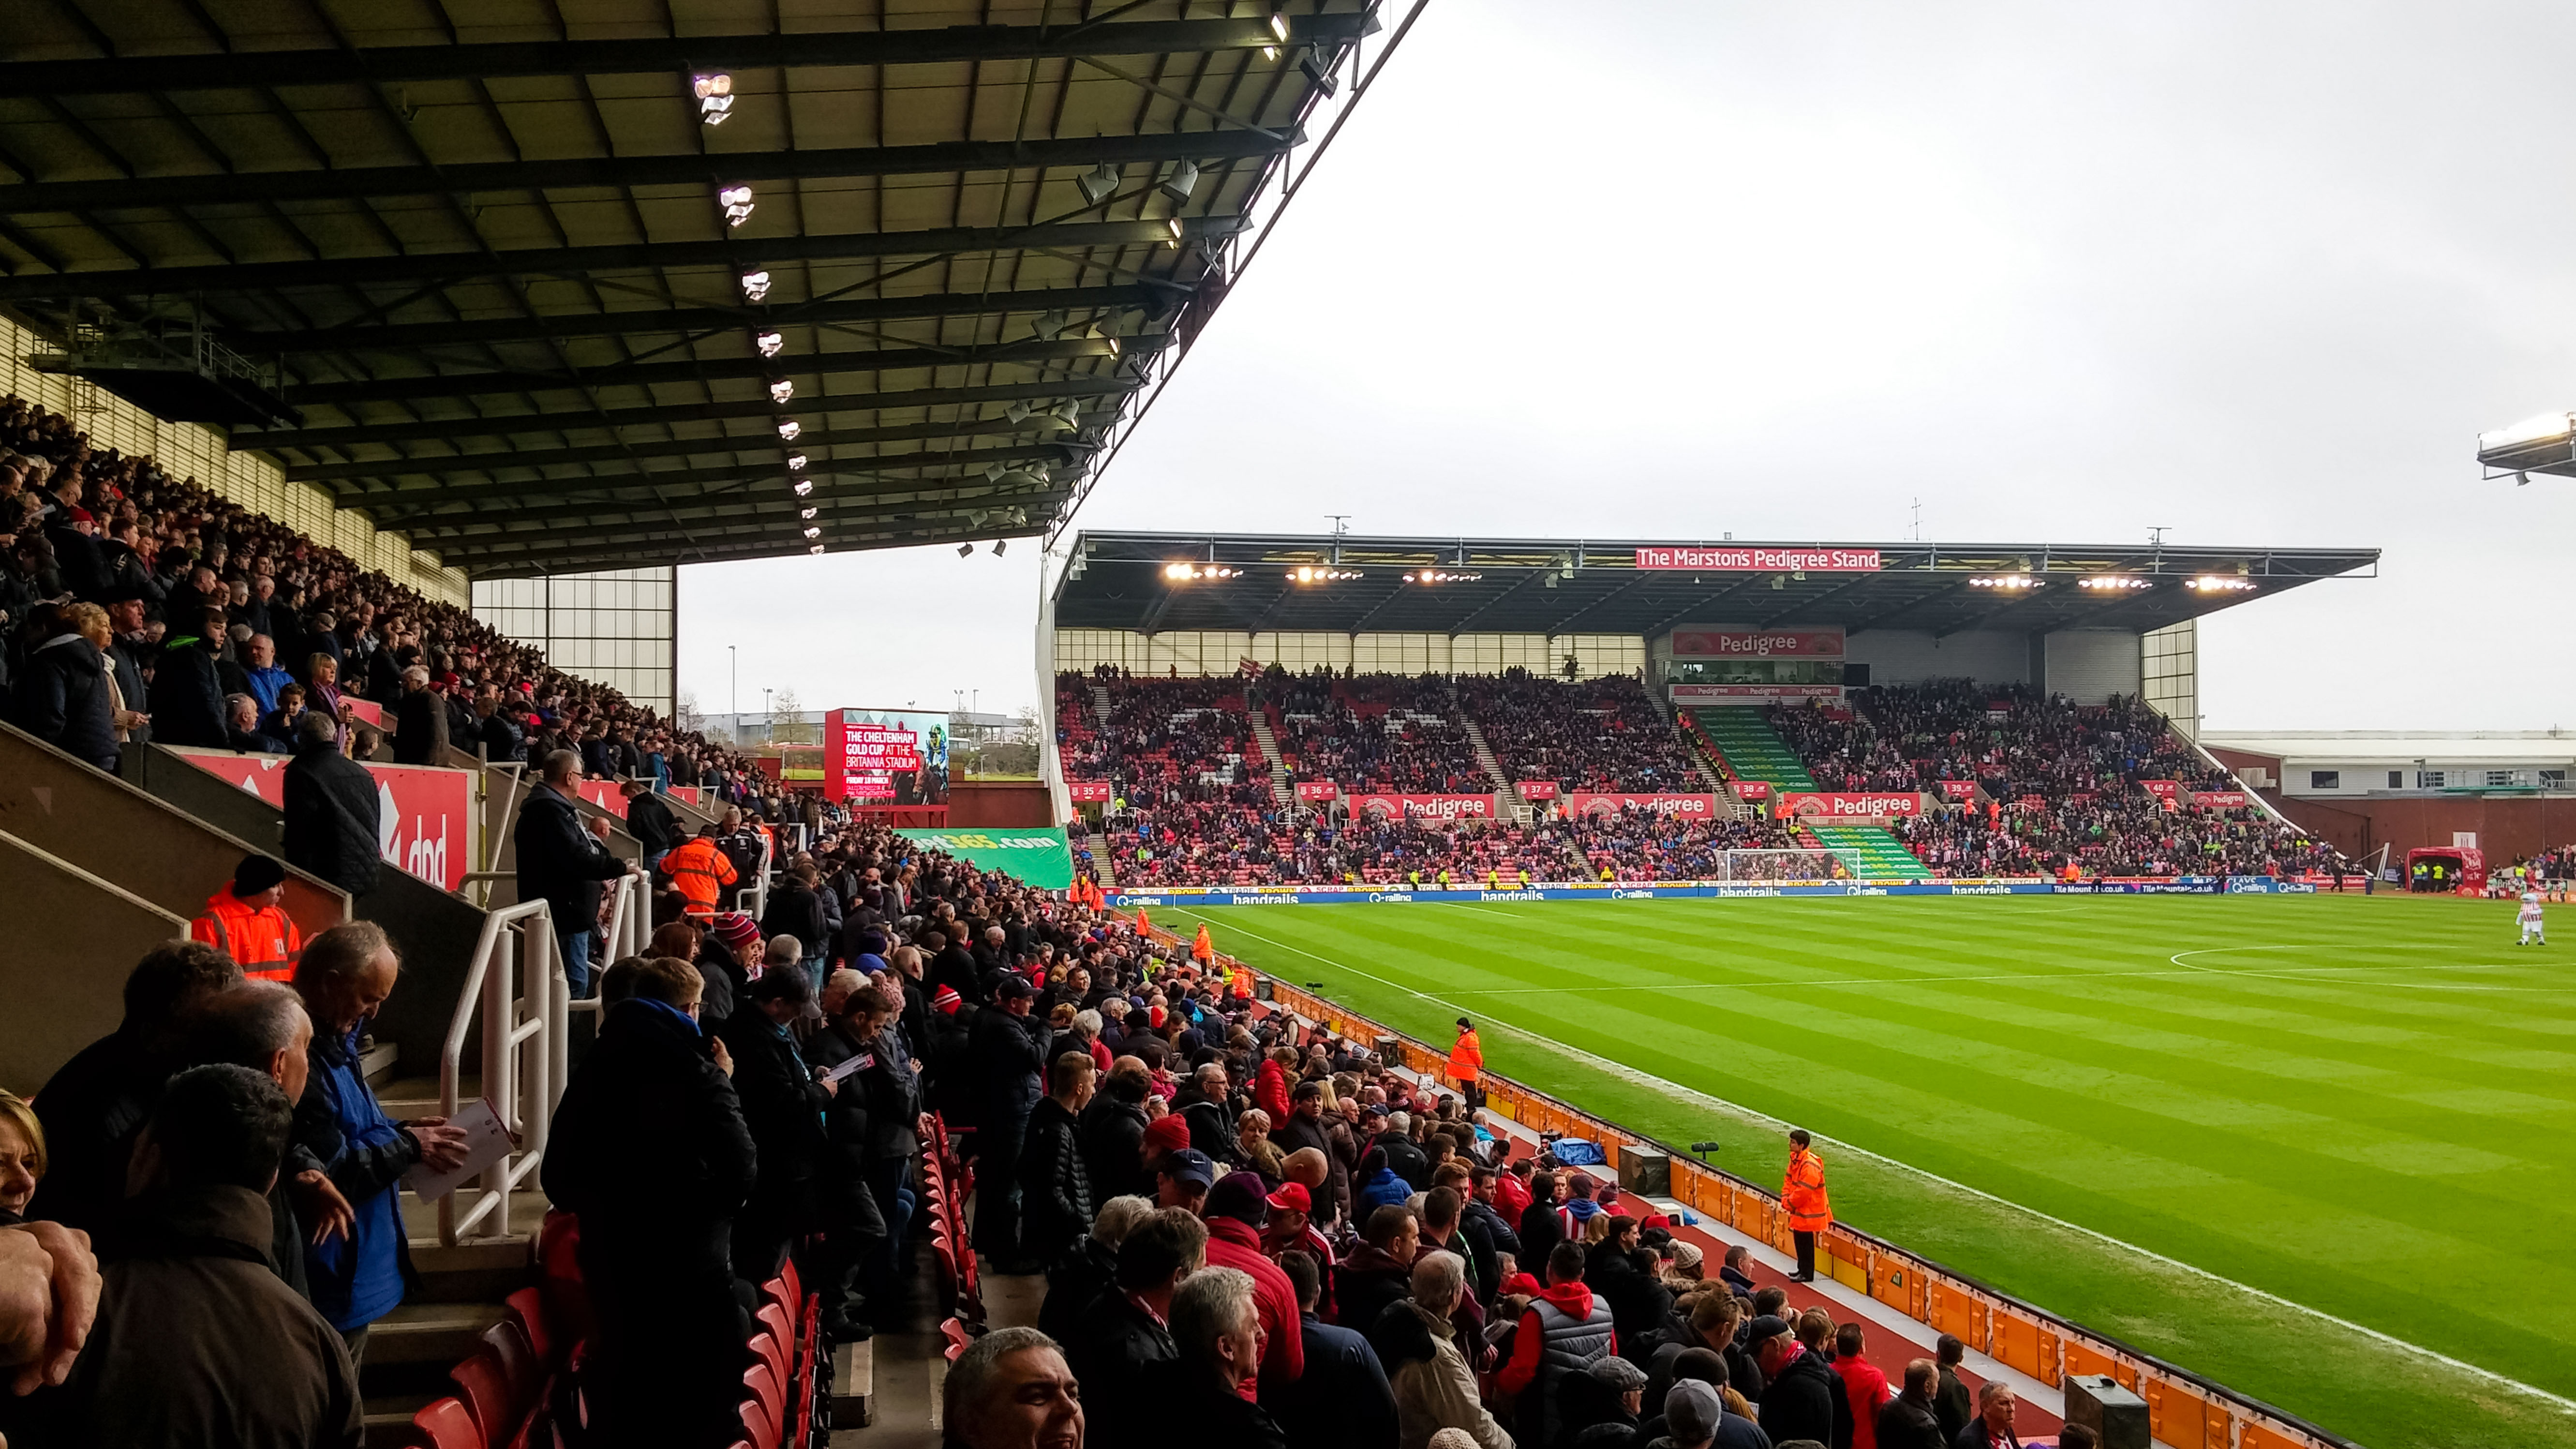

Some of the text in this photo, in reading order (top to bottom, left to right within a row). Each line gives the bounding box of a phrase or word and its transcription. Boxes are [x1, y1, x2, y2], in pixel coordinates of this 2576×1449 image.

[1637, 549, 1879, 570] The Marston's Pedigree Stand
[1720, 634, 1797, 656] Pedigree
[1697, 687, 1728, 696] Pedigree
[1749, 687, 1780, 696] Pedigree
[1801, 687, 1831, 696] Pedigree
[846, 731, 914, 744] THE CHELTENHAM
[846, 744, 910, 756] GOLD CUP AT THE
[846, 756, 917, 768] BRITANNIA STADIUM
[1083, 787, 1094, 795] 35
[1531, 785, 1541, 793] 37
[2213, 795, 2243, 805] Pedigree
[1834, 796, 1911, 818] Pedigree
[1952, 885, 2011, 895] handrails
[2232, 882, 2267, 894] Q-railing
[1233, 894, 1299, 905] handrails
[1480, 890, 1544, 901] handrails
